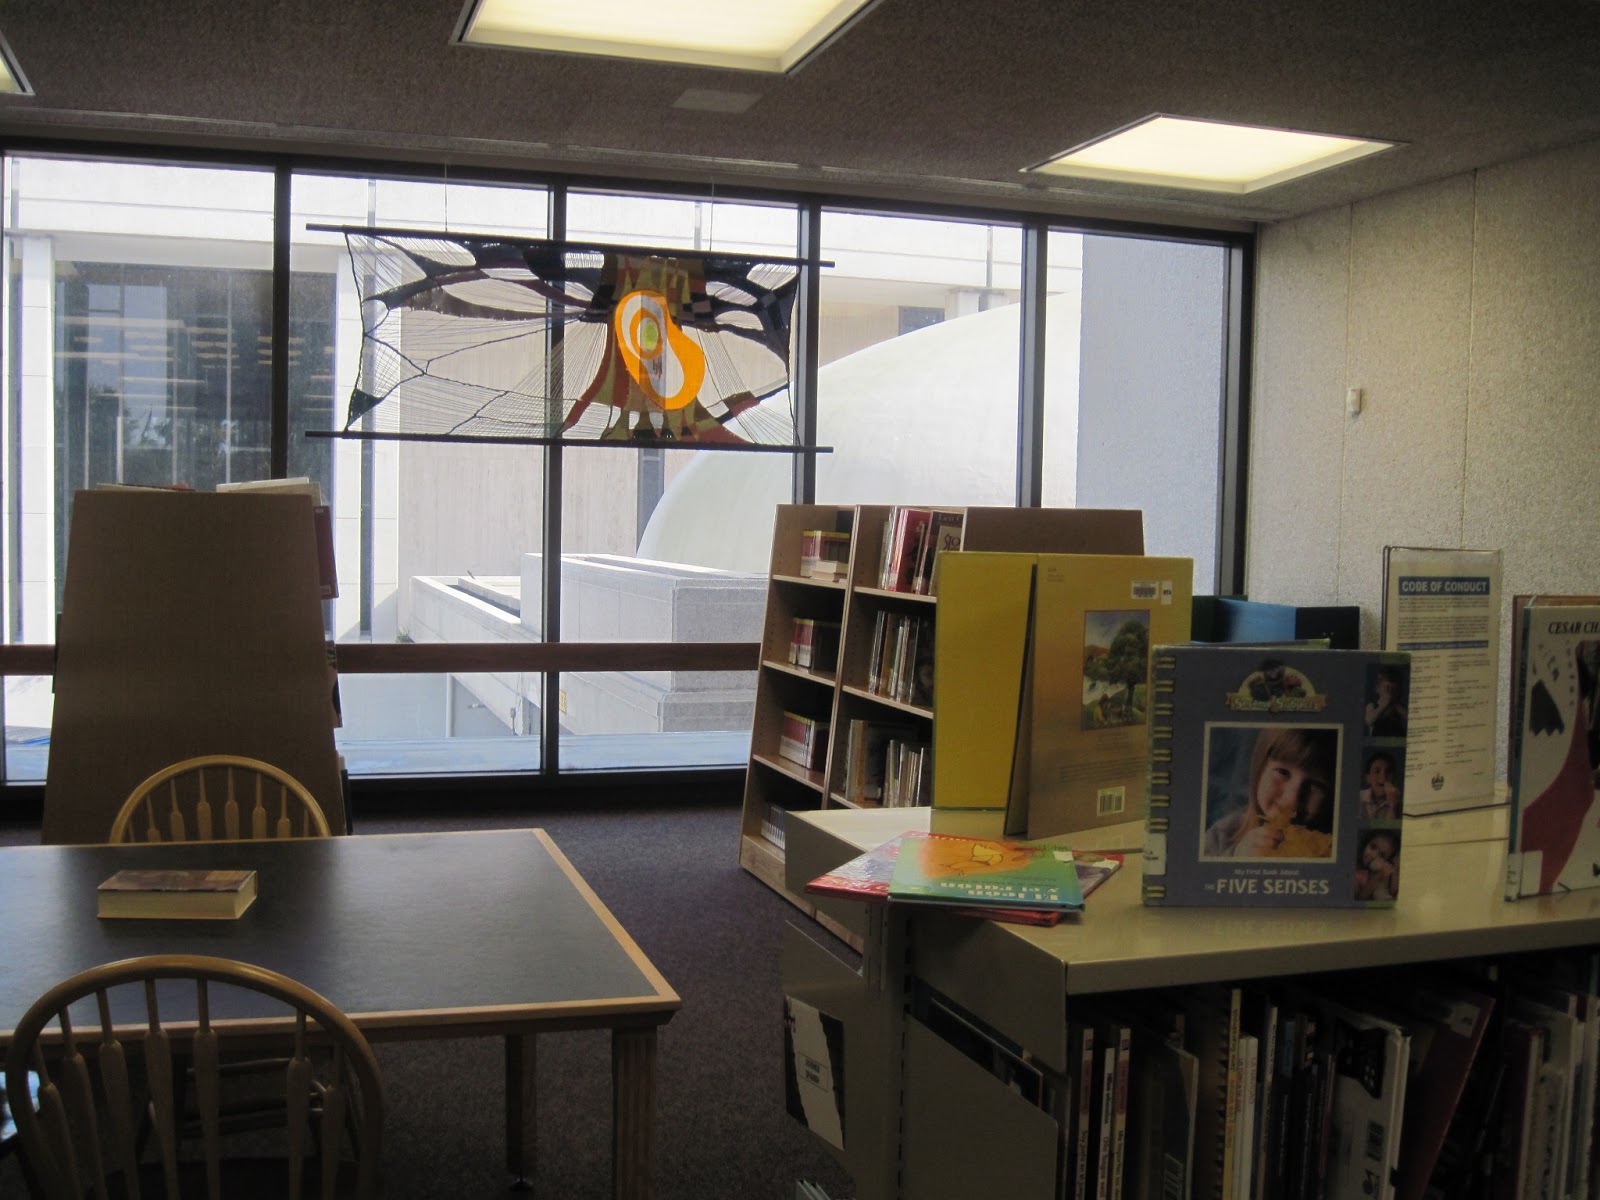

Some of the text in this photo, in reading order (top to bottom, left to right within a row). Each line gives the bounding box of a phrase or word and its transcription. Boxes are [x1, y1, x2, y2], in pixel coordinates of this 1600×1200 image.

[1401, 581, 1488, 592] CODE OF CONDUCT
[1548, 620, 1600, 634] CESAR CH
[1216, 878, 1258, 894] FIVE
